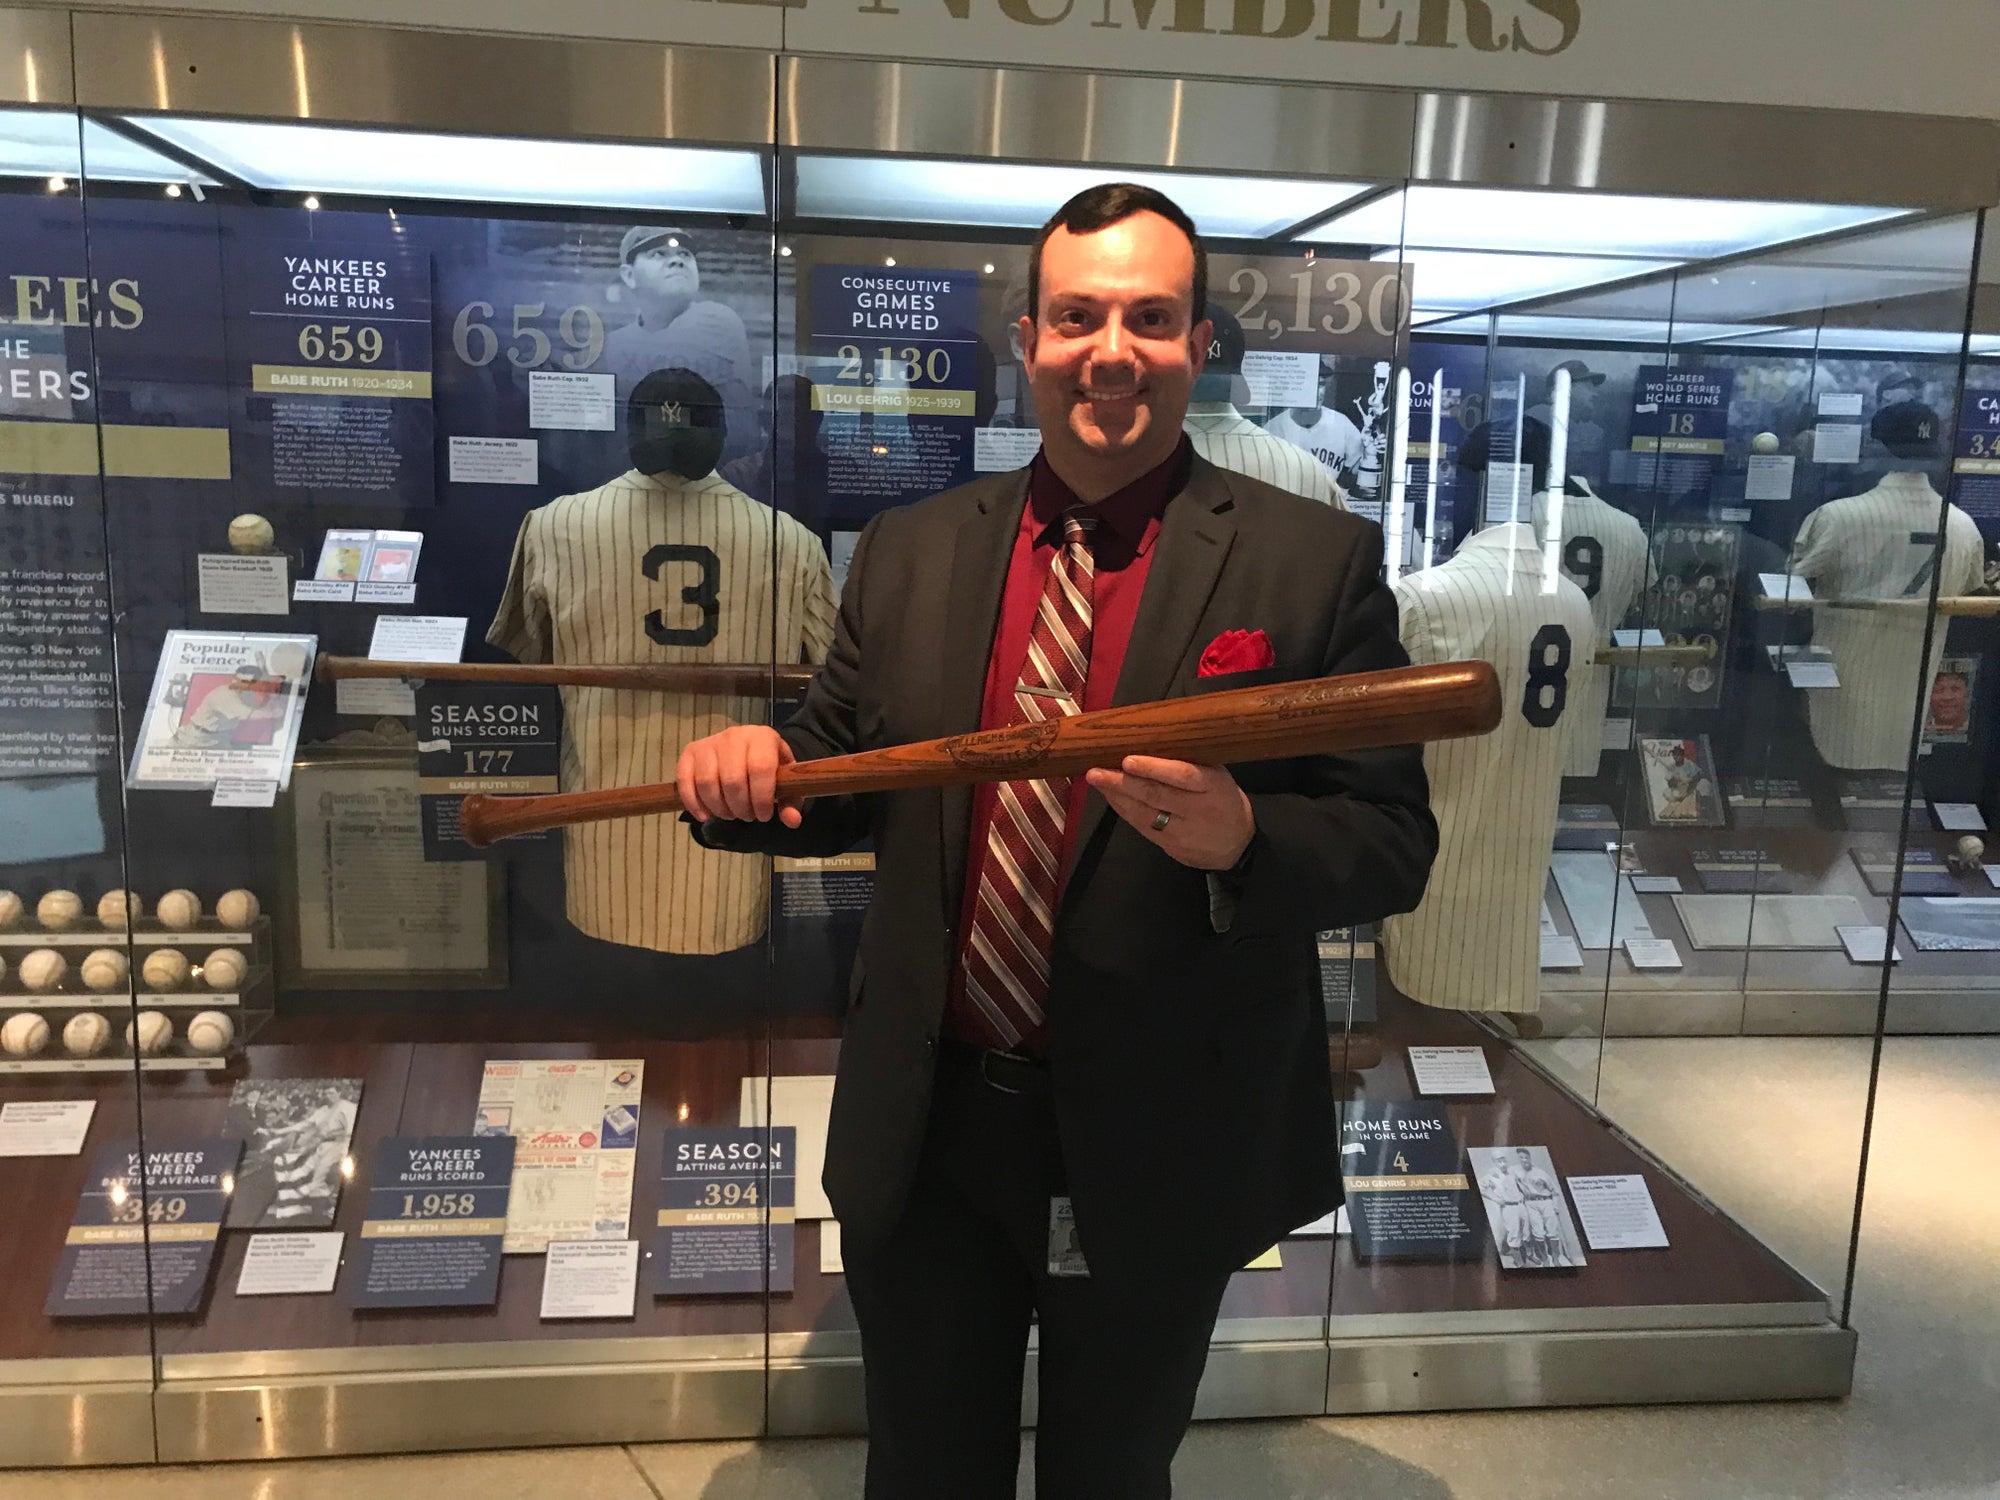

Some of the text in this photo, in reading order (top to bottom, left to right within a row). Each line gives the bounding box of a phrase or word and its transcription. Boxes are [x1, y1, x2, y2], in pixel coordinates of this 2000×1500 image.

[284, 256, 387, 277] YANKEES
[292, 275, 381, 294] CAREER
[841, 277, 951, 293] CONSECUTIVE
[0, 275, 143, 329] EES
[285, 292, 395, 310] HOME RUNS
[857, 293, 935, 311] GAMES
[1229, 267, 1411, 340] 2,130
[852, 312, 939, 330] PLAYED
[453, 300, 605, 371] 659
[298, 324, 384, 363] 659
[836, 345, 951, 384] 2,130
[0, 369, 90, 400] ERS
[270, 374, 309, 386] BABE
[312, 375, 348, 388] RUTH
[1646, 383, 1721, 394] WORLD SERIES
[827, 394, 852, 404] LOU
[855, 394, 902, 406] GEHRIG
[1687, 395, 1719, 405] RUNS
[1668, 413, 1695, 434] 18
[13, 495, 74, 506] BUREAU
[1563, 535, 1604, 601] 9
[1902, 531, 1943, 596] 7
[641, 543, 721, 648] 3
[95, 599, 106, 607] th
[7, 624, 63, 636] legendary
[48, 646, 72, 655] New
[76, 646, 101, 656] York
[183, 642, 250, 655] Popular
[179, 654, 247, 666] Science
[1521, 623, 1572, 728] 8
[71, 686, 109, 696] Sports
[430, 704, 539, 723] SEASON
[432, 725, 540, 737] RUNS SCORED
[50, 733, 64, 744] by
[463, 750, 514, 774] 177
[450, 780, 530, 790] BABE RUTH 1921
[796, 858, 822, 866] BABE
[825, 858, 850, 866] RUTH
[1343, 1120, 1442, 1131] HOME RUNS
[1401, 1132, 1430, 1140] GAME
[408, 1149, 481, 1161] YANKEES
[678, 1142, 781, 1160] SEASON
[411, 1161, 475, 1172] CAREER
[676, 1163, 726, 1171] BATTING
[1393, 1151, 1409, 1172] 4
[102, 1175, 217, 1186] BATTIG AVERAGE
[400, 1171, 485, 1182] RUNS SCORED
[695, 1182, 759, 1206] .394
[402, 1193, 476, 1219] 1,958
[686, 1213, 714, 1221] BABE
[377, 1225, 406, 1233] BABE
[409, 1224, 438, 1232] RUTH
